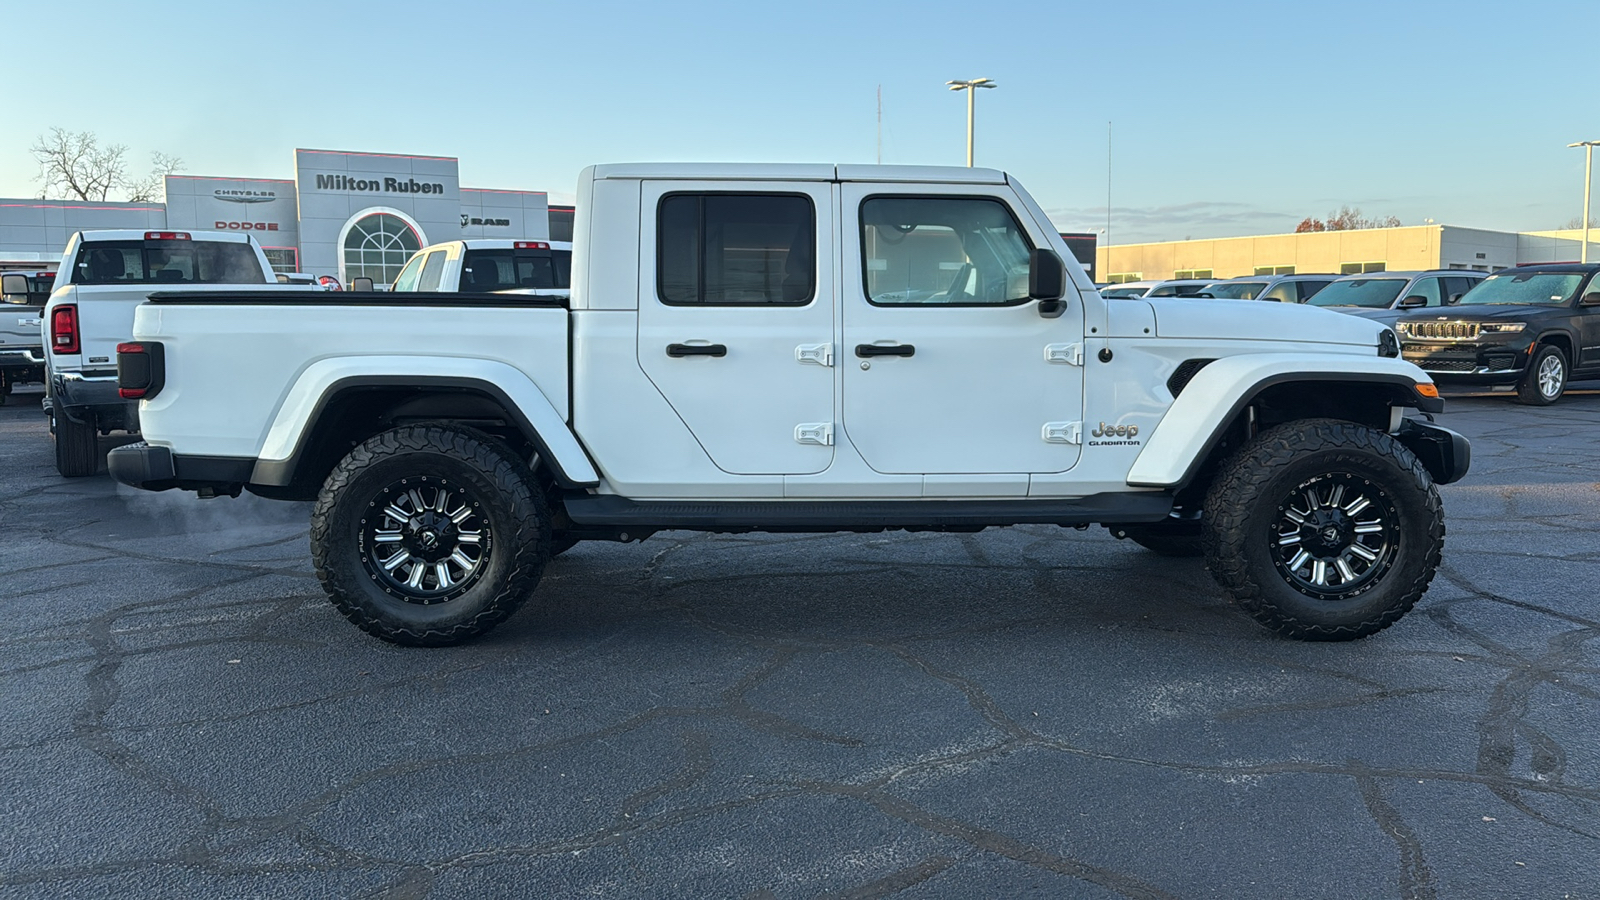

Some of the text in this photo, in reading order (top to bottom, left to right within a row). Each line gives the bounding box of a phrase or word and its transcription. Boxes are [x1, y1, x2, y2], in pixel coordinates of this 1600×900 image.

[316, 174, 443, 194] Milton Ruben
[214, 189, 276, 197] CHRYSLER
[214, 221, 279, 231] DODGE
[470, 217, 510, 227] RAM
[1091, 421, 1139, 440] Jeep
